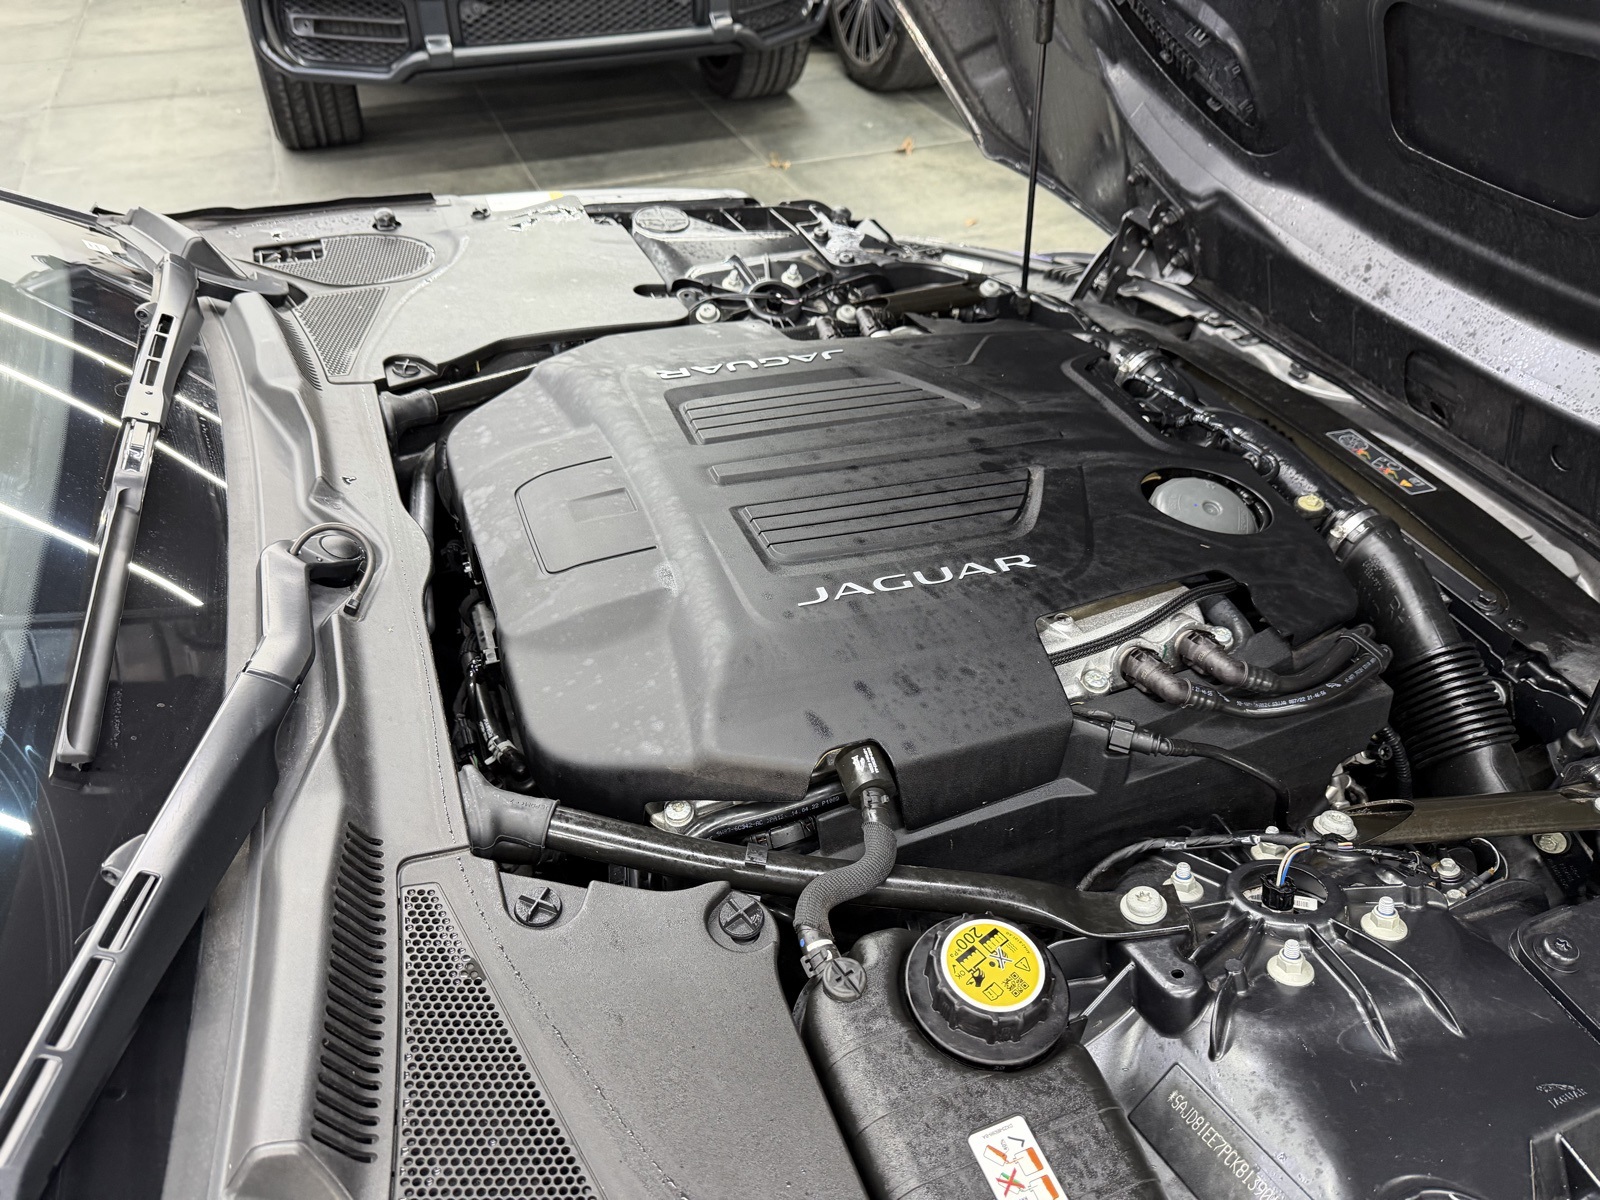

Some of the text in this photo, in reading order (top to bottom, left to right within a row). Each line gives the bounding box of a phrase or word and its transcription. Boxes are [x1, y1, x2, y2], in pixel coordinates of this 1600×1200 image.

[656, 349, 844, 380] JAGUAR
[797, 554, 1037, 607] JAGUAR
[950, 927, 983, 958] 200 kPa
[955, 969, 966, 980] OK
[1548, 1088, 1588, 1109] JAGUAR
